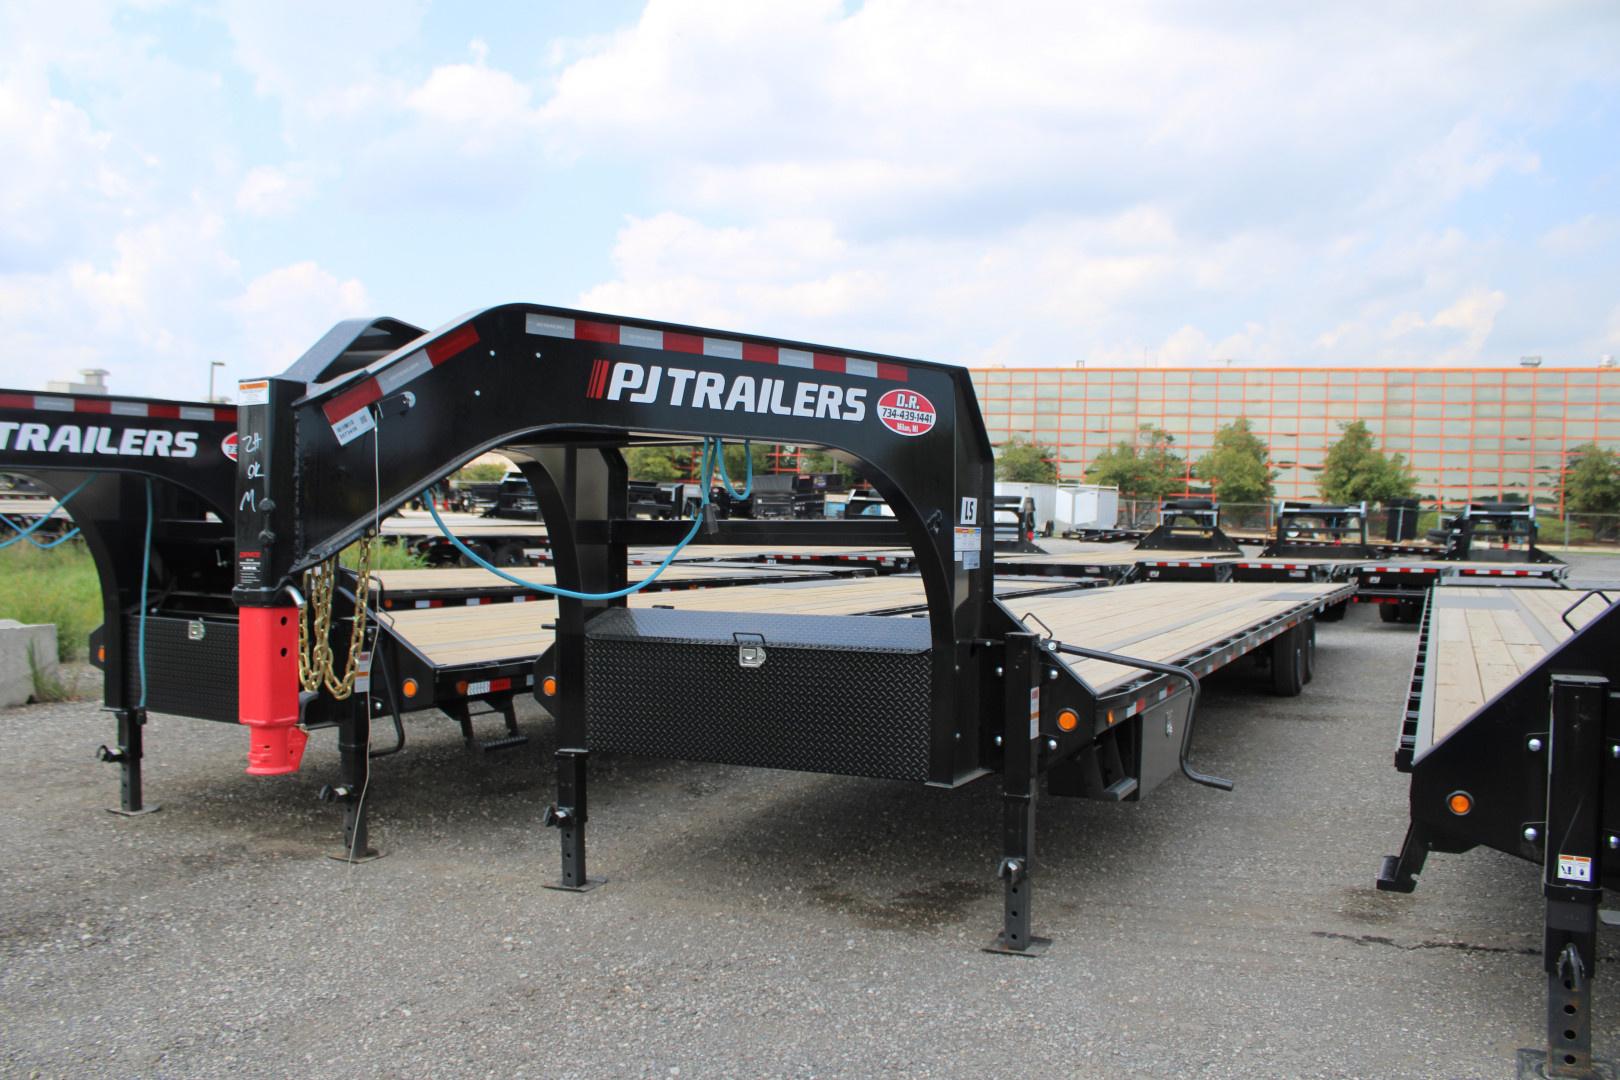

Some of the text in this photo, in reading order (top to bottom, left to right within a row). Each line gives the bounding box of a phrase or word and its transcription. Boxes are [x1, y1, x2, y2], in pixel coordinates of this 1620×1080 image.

[667, 367, 867, 422] TRAILERS
[896, 393, 920, 410] D.R.
[882, 407, 933, 424] 734-439-1441
